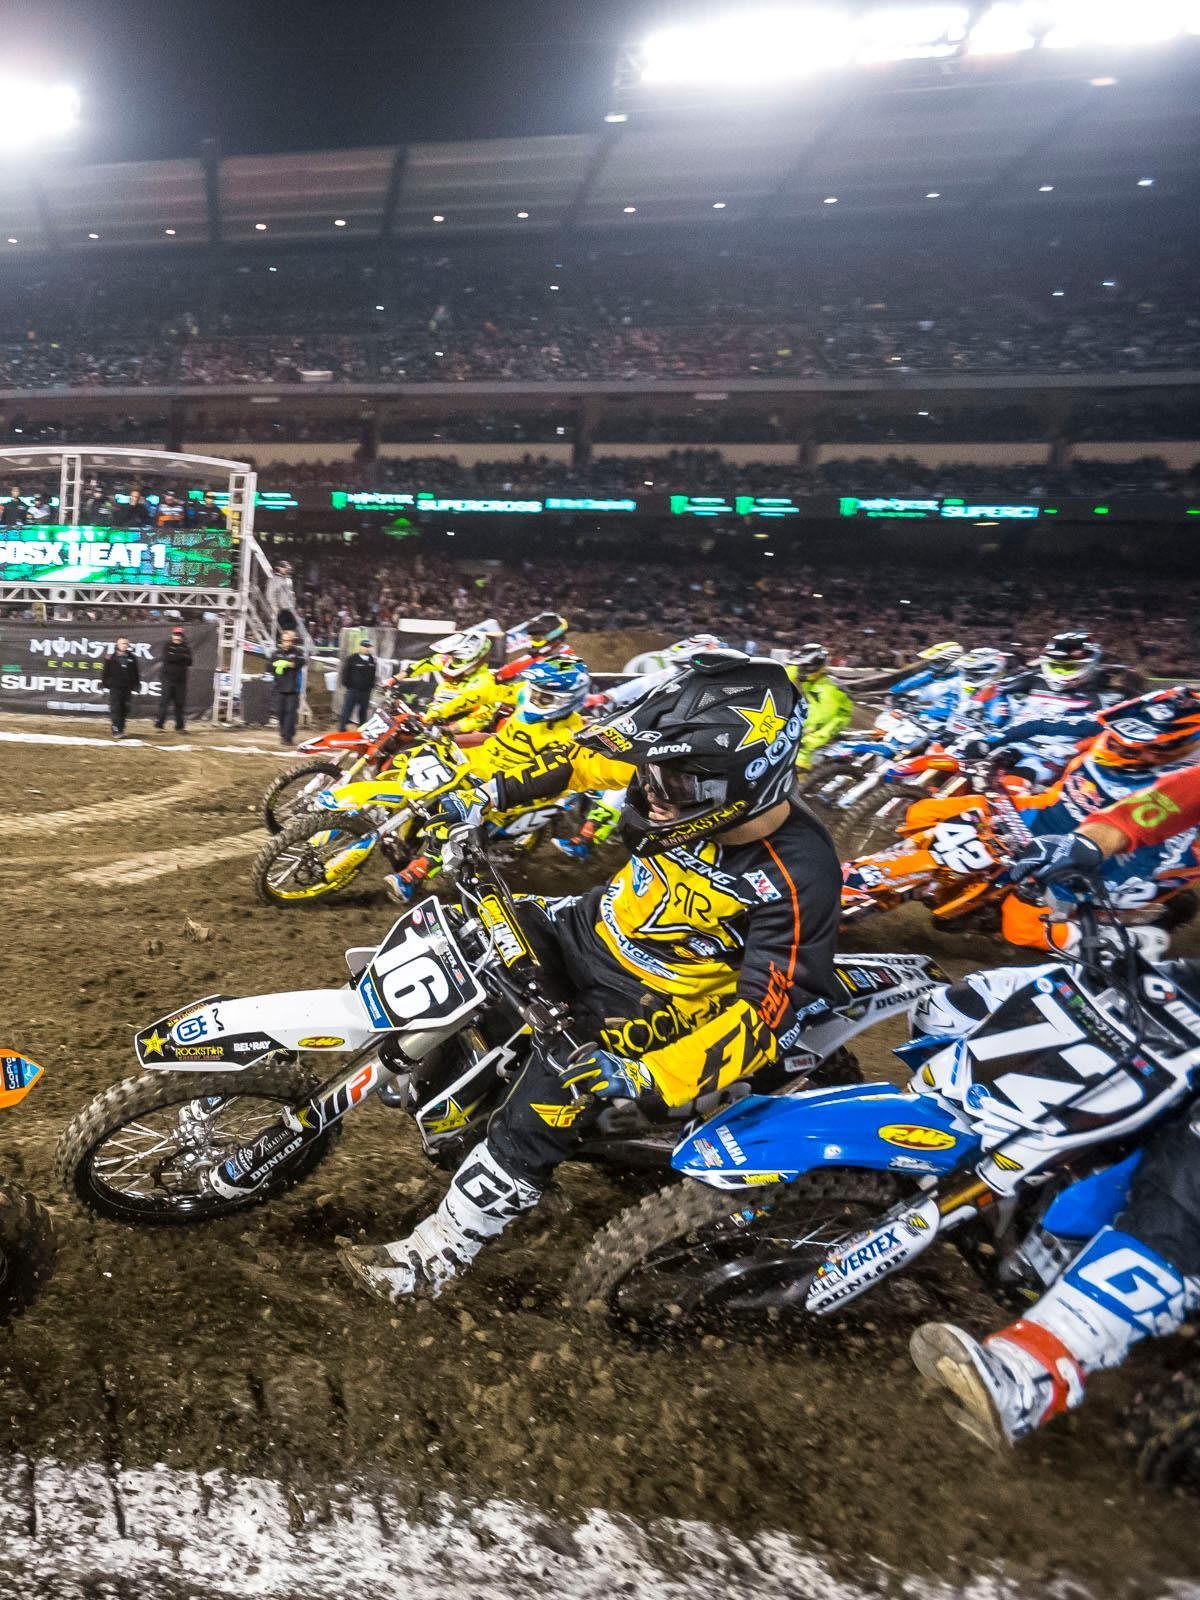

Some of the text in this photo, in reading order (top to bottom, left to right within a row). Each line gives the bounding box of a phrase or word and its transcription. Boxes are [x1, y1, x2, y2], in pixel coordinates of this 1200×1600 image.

[417, 499, 543, 513] SUPERCROSS
[67, 542, 148, 568] HEAT
[150, 543, 166, 568] 1
[47, 659, 105, 671] ENER
[647, 743, 692, 757] Airoh
[406, 753, 454, 792] 45
[935, 821, 994, 874] 42
[374, 926, 449, 1019] 16
[6, 1057, 16, 1090] GoPro
[966, 992, 1145, 1137] 72
[714, 1124, 748, 1166] YAMAHA
[878, 1125, 957, 1149] FMF
[250, 1136, 304, 1182] DUNLOP
[833, 1227, 902, 1277] VERTEX
